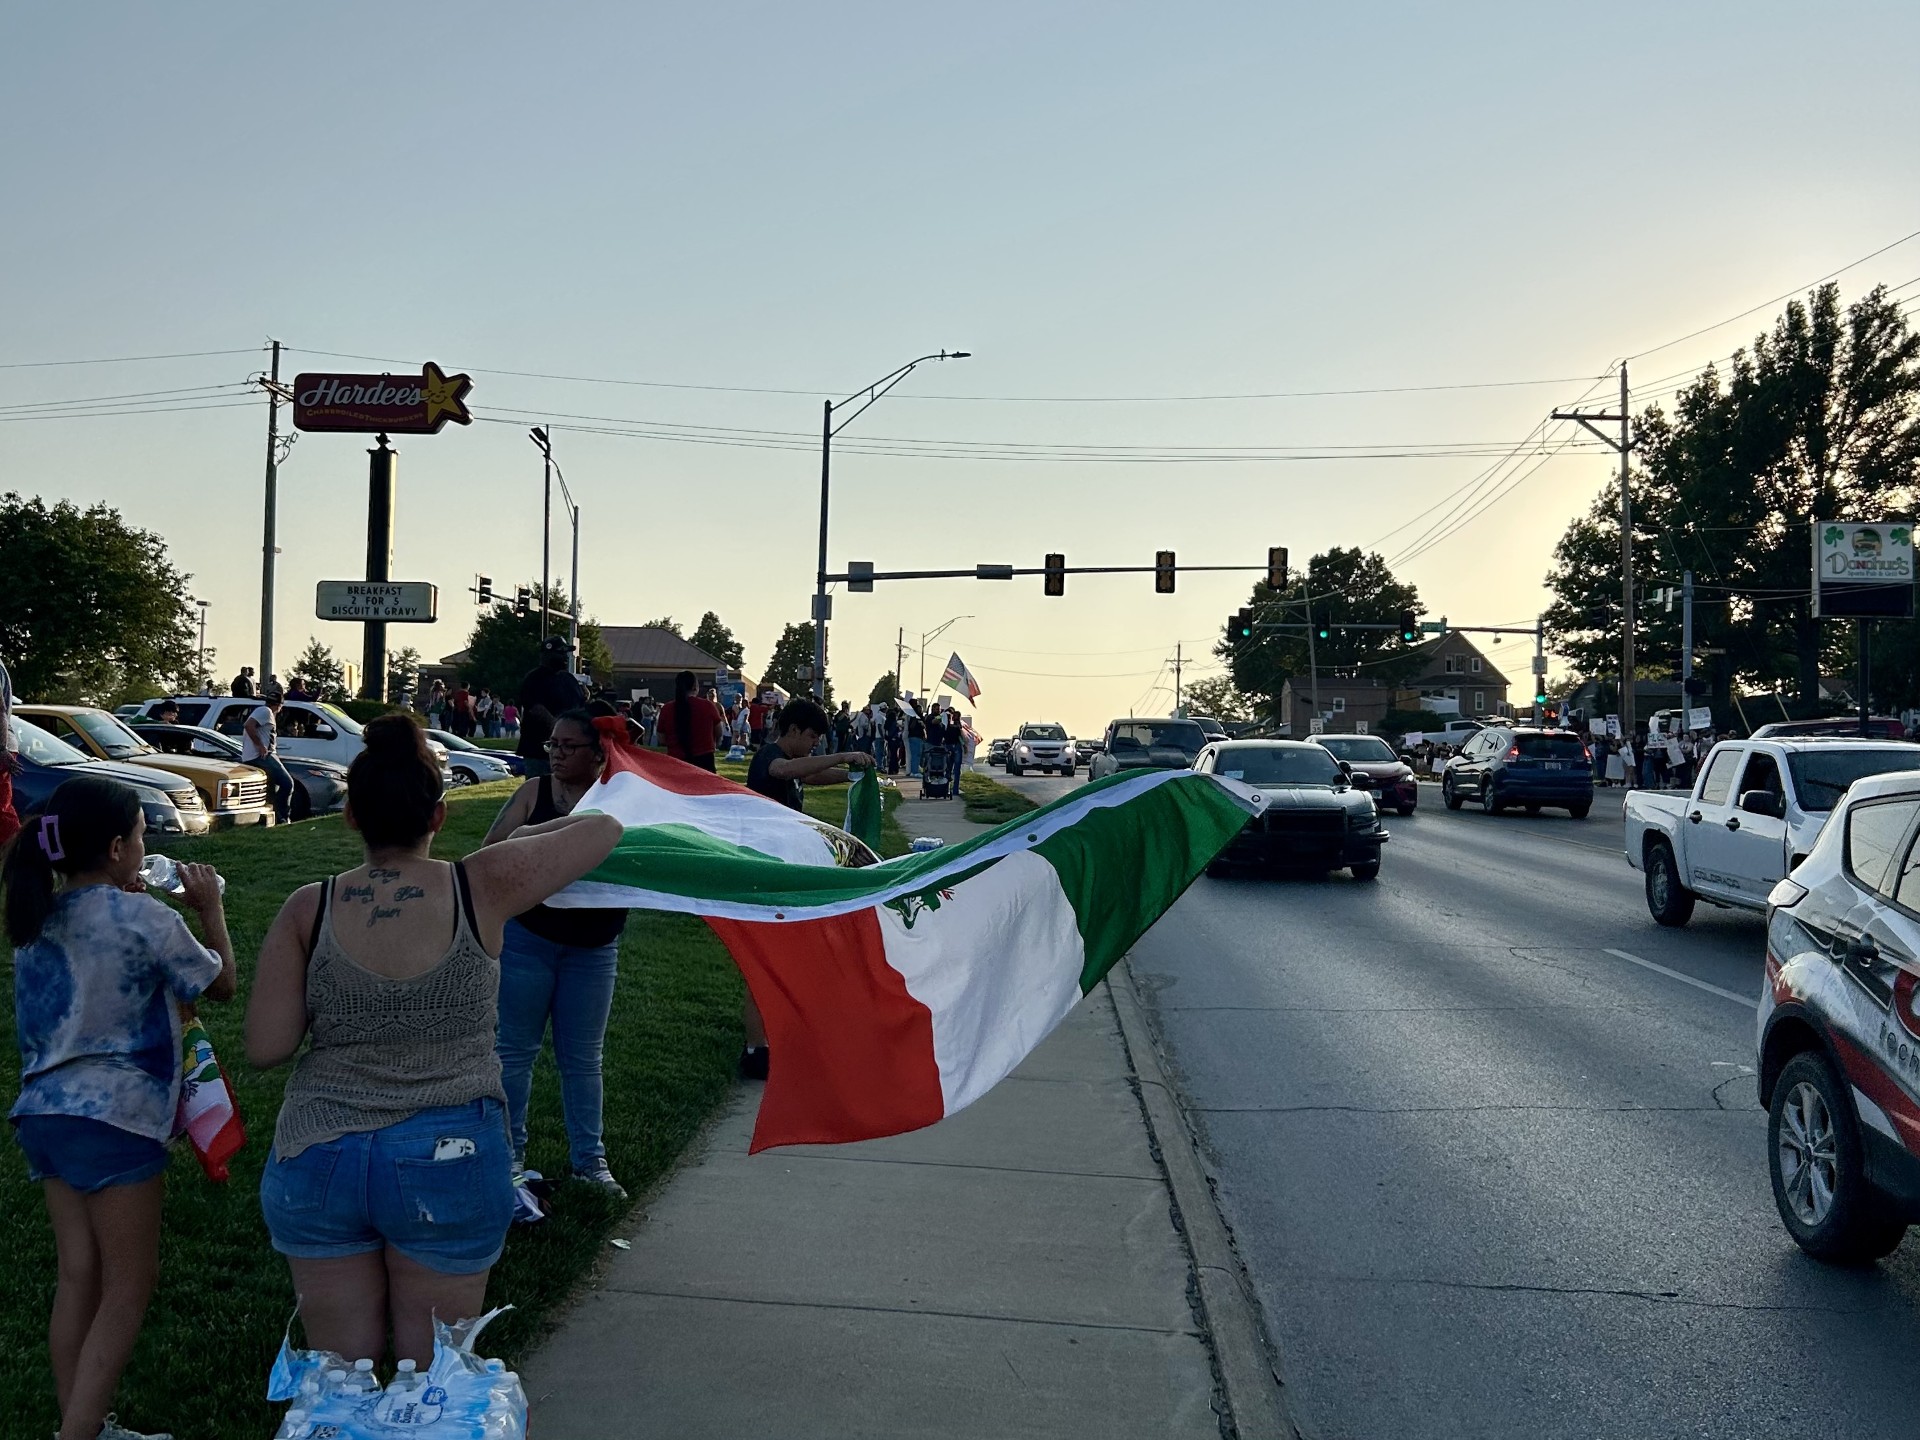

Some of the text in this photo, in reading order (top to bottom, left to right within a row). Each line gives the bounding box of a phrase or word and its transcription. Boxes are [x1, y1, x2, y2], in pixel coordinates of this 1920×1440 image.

[300, 379, 428, 407] Hardee's
[347, 586, 403, 596] BREAKFAST
[351, 596, 356, 605] 2
[366, 596, 384, 605] FOR
[332, 606, 418, 616] BISCUIT N GRAVY
